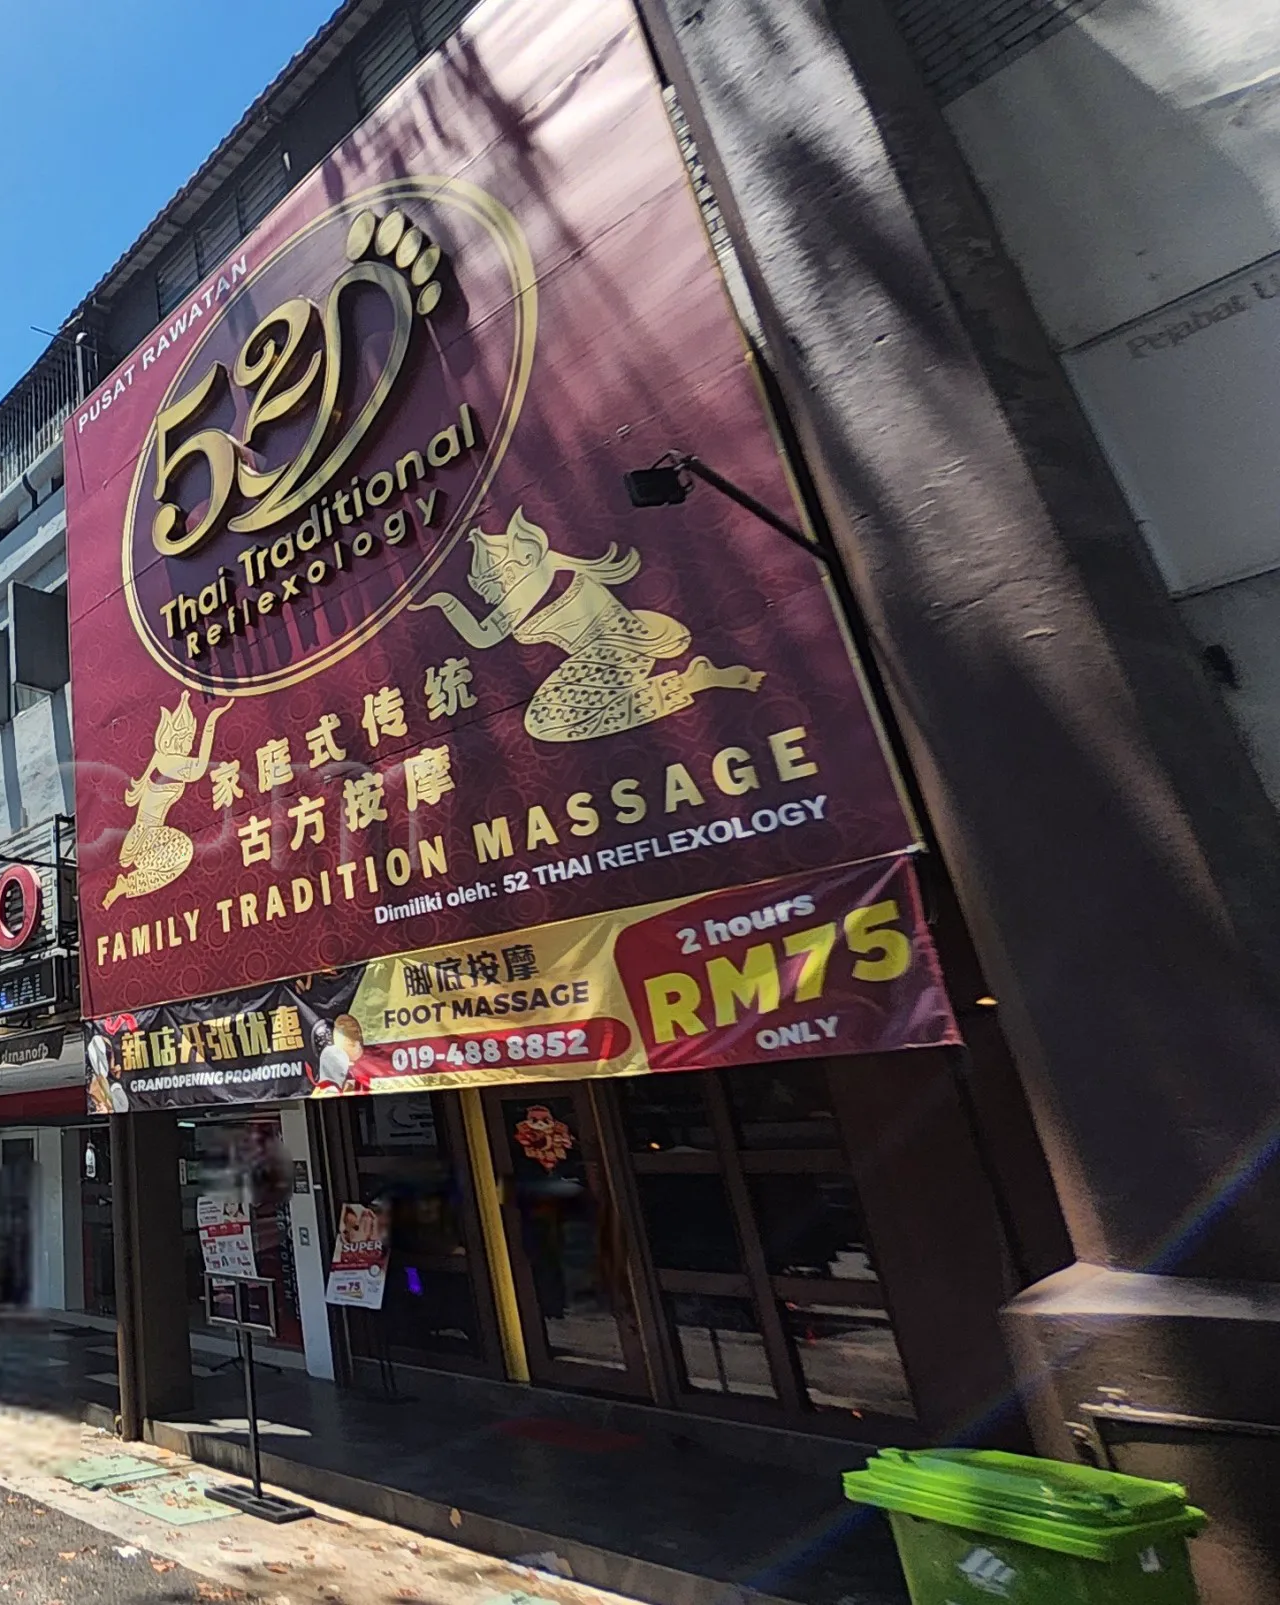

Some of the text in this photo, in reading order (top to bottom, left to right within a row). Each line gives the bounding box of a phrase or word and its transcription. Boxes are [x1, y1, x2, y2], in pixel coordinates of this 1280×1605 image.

[77, 254, 248, 434] PUSAT RAWATAN
[160, 402, 477, 638] Thai Traditional
[186, 488, 439, 659] Reflexology
[210, 656, 478, 812] 家庭式传统
[97, 726, 819, 966] FAMILY TRADITION MASSAGE
[238, 744, 456, 868] 古方按摩
[374, 794, 828, 926] Dimiliki oleh: 52 THAI REFLEXOLOGY
[643, 900, 911, 1044] RM75
[676, 894, 816, 955] 2 hours
[120, 1005, 305, 1072] 新店开张优惠
[383, 980, 590, 1029] FOOT MASSAGE
[391, 1028, 589, 1072] 019-488 8852
[756, 1016, 838, 1050] ONLY
[224, 1061, 303, 1085] PROMOTION
[342, 1240, 384, 1252] SUPER
